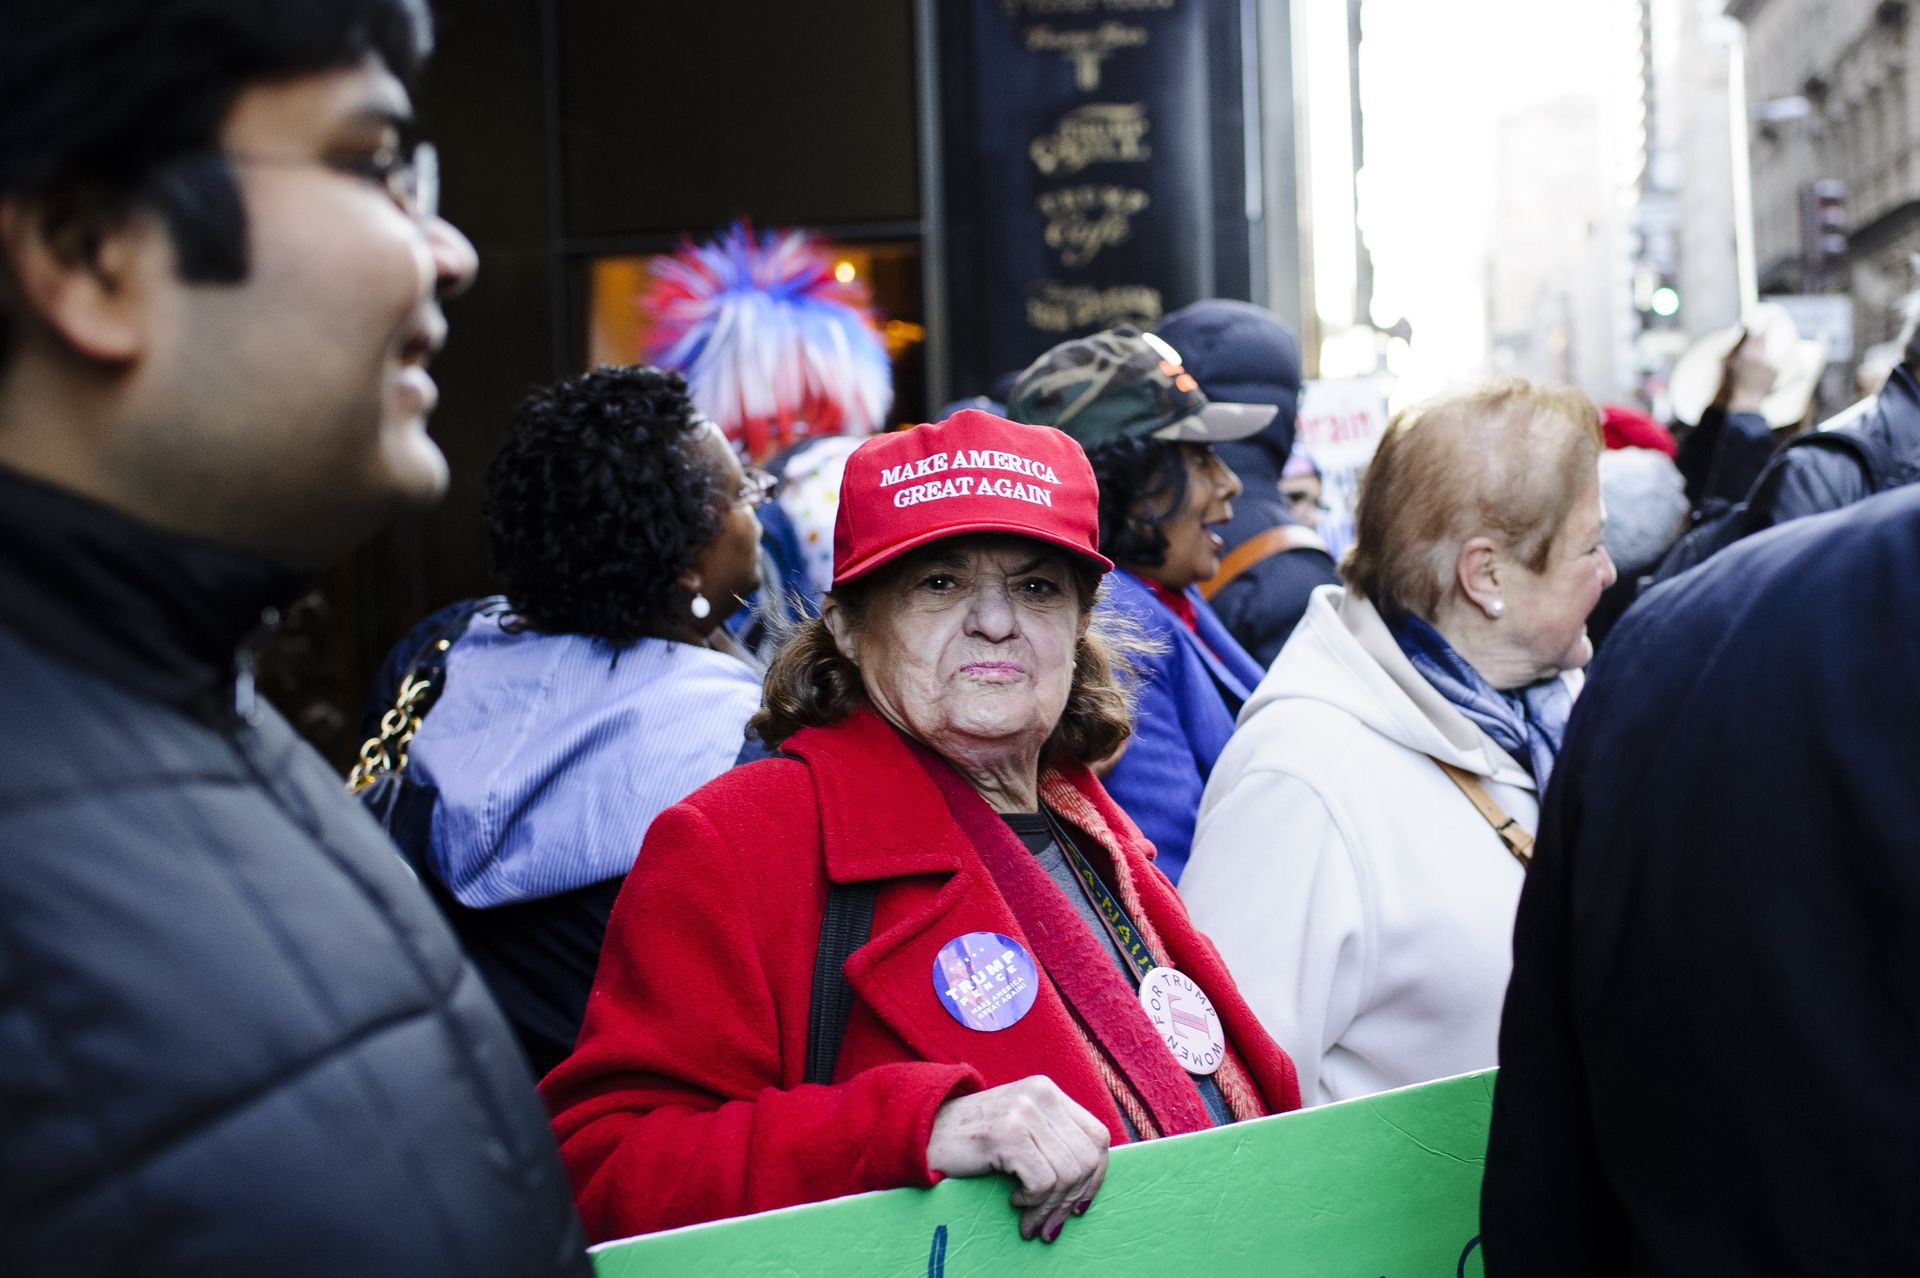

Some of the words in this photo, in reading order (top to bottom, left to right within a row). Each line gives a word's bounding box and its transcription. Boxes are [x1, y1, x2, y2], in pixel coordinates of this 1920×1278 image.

[879, 452, 949, 487] MAKE
[951, 450, 1062, 485] AMERICA
[893, 476, 974, 508] GREAT
[975, 477, 1052, 507] AGAIN
[945, 950, 1015, 1001] TRUMP
[959, 964, 1018, 1006] PENCE
[970, 998, 992, 1015] MAKE
[992, 976, 1024, 1001] AMERICA
[977, 1000, 1001, 1019] GREAT
[1150, 985, 1165, 1025] FOR
[1161, 974, 1215, 1017] TRUMP
[1167, 1035, 1223, 1067] WOMEN
